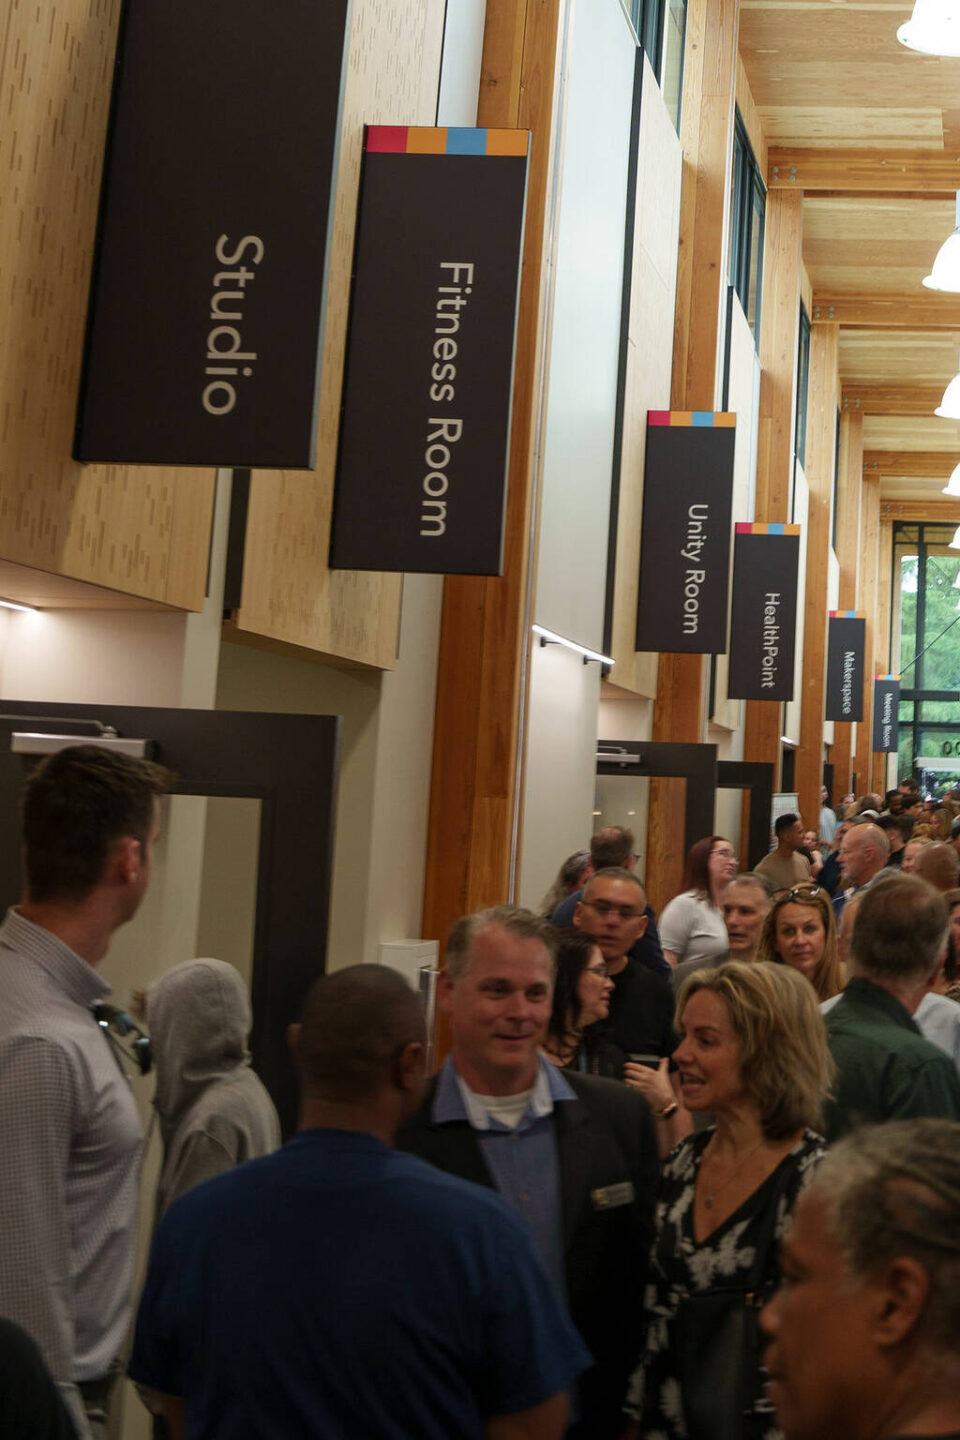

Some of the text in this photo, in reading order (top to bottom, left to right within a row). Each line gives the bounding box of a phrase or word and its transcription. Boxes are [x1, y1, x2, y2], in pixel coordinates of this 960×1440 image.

[202, 233, 265, 416] Studio
[419, 262, 474, 536] Fitness Room
[680, 504, 708, 634] Unity Room
[760, 592, 781, 688] HealthPoint
[840, 651, 856, 715] Makerspace
[882, 725, 893, 748] Room
